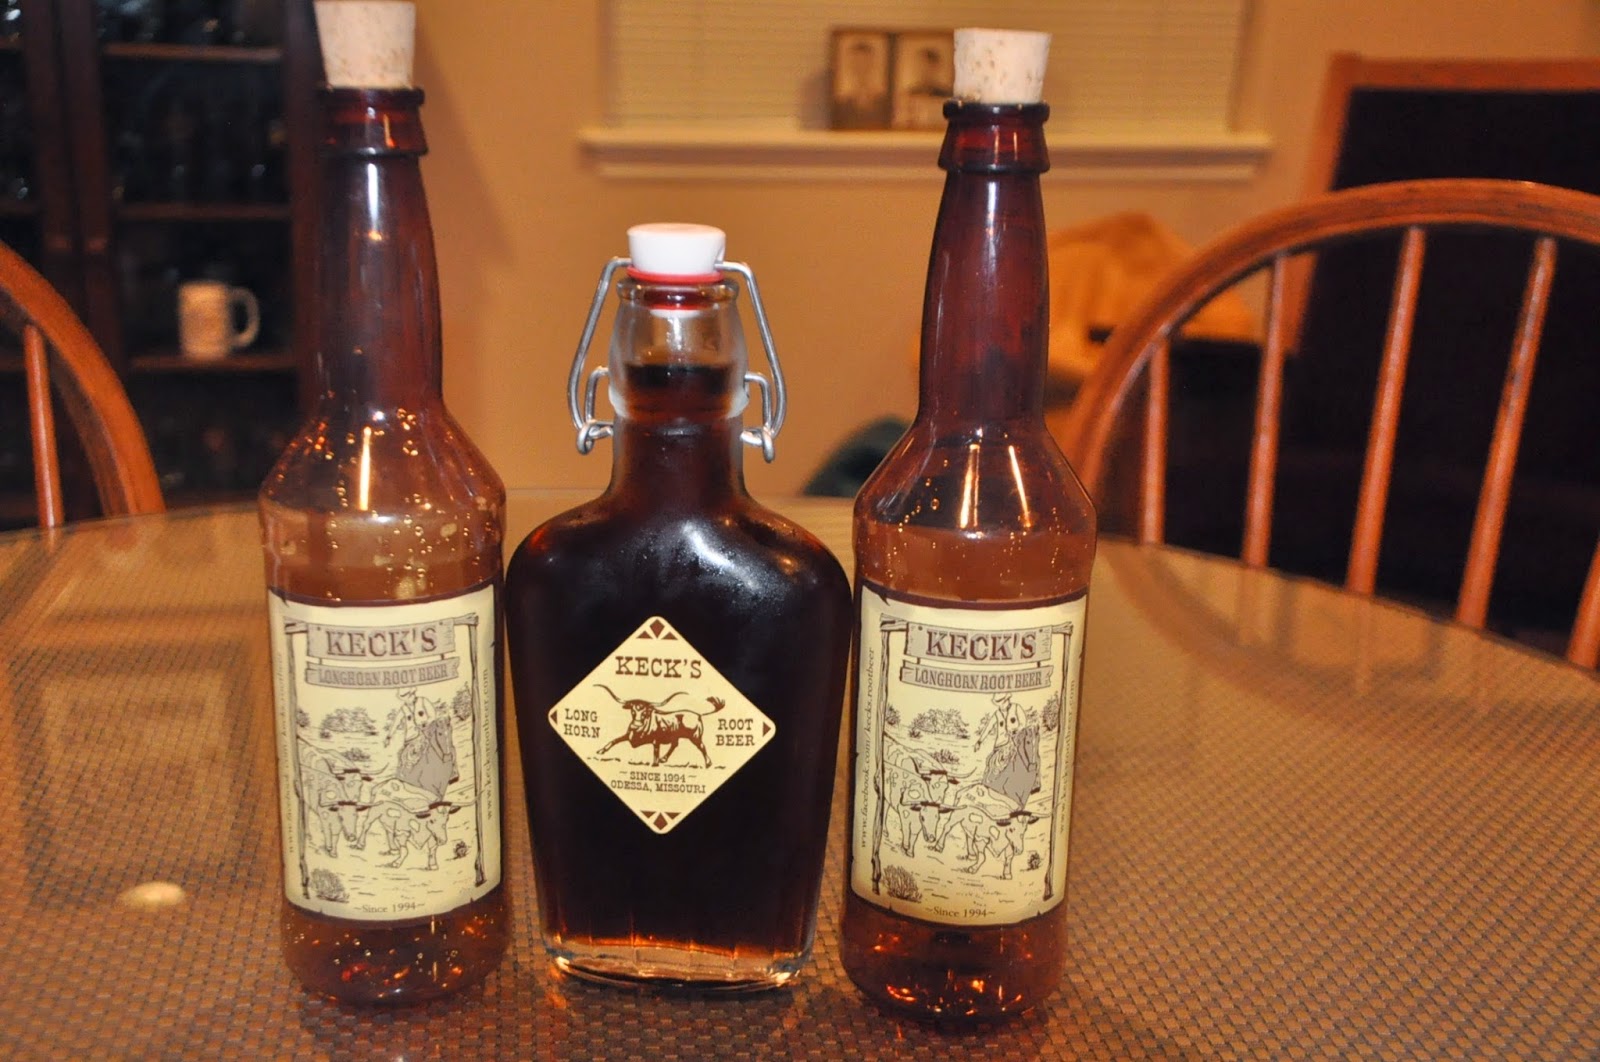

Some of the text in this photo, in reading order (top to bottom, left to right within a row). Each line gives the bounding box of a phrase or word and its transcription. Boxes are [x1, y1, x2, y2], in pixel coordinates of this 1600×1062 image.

[325, 627, 438, 657] KECK'S
[925, 630, 1037, 661] KECK'S
[318, 664, 448, 686] LONGHORN ROOT BEER
[615, 656, 702, 679] KECK'S
[914, 668, 1042, 690] LONGHORN ROOT BEER
[565, 708, 598, 723] LONG
[563, 723, 601, 739] HORN
[717, 718, 754, 731] ROOT
[715, 734, 756, 747] BEER
[629, 771, 686, 783] SINCE 1994
[610, 780, 706, 794] ODESSA, MISSOURI
